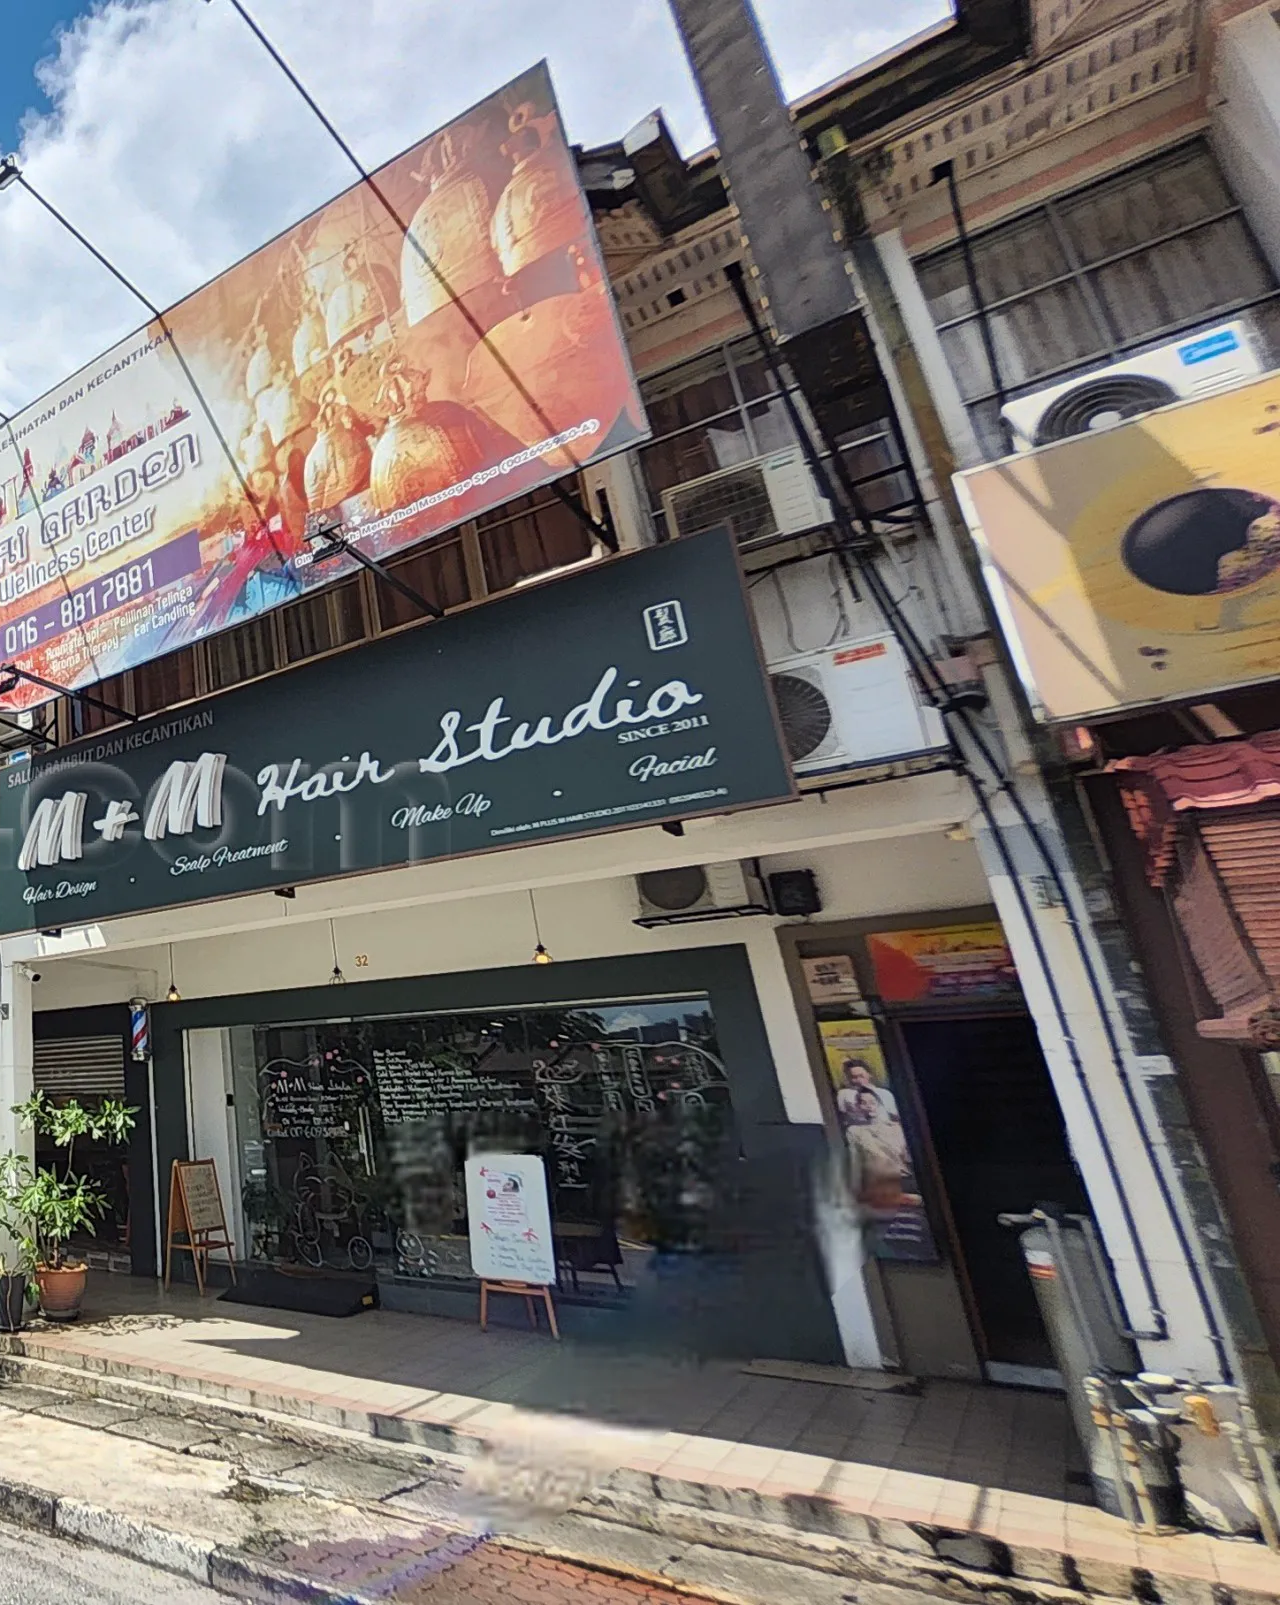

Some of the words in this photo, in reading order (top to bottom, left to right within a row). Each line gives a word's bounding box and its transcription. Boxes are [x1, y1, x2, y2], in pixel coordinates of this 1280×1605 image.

[59, 387, 84, 411] DAN
[86, 328, 174, 392] KECANTIKAN
[361, 516, 392, 537] Merry
[393, 504, 418, 521] Thai
[418, 479, 472, 511] Massage
[472, 466, 499, 487] Spa
[86, 505, 154, 558] Center
[6, 616, 38, 654] 016
[61, 586, 97, 628] 881
[102, 558, 156, 610] 7881
[134, 618, 151, 638] Ear
[151, 601, 197, 630] Candling
[45, 749, 95, 775] RAMBUT
[96, 739, 124, 760] DAN
[125, 710, 214, 750] KECANTIKAN
[618, 723, 671, 744] SINCE
[671, 715, 709, 733] 2011
[18, 791, 88, 871] M
[144, 752, 228, 840] M
[257, 750, 395, 816] Hair
[419, 666, 704, 773] Studio
[628, 746, 719, 782] Facial
[391, 804, 453, 830] Make
[455, 792, 492, 820] Up
[170, 856, 211, 876] Scalp
[22, 886, 54, 906] Hair
[55, 880, 98, 901] Design
[354, 954, 369, 967] 32
